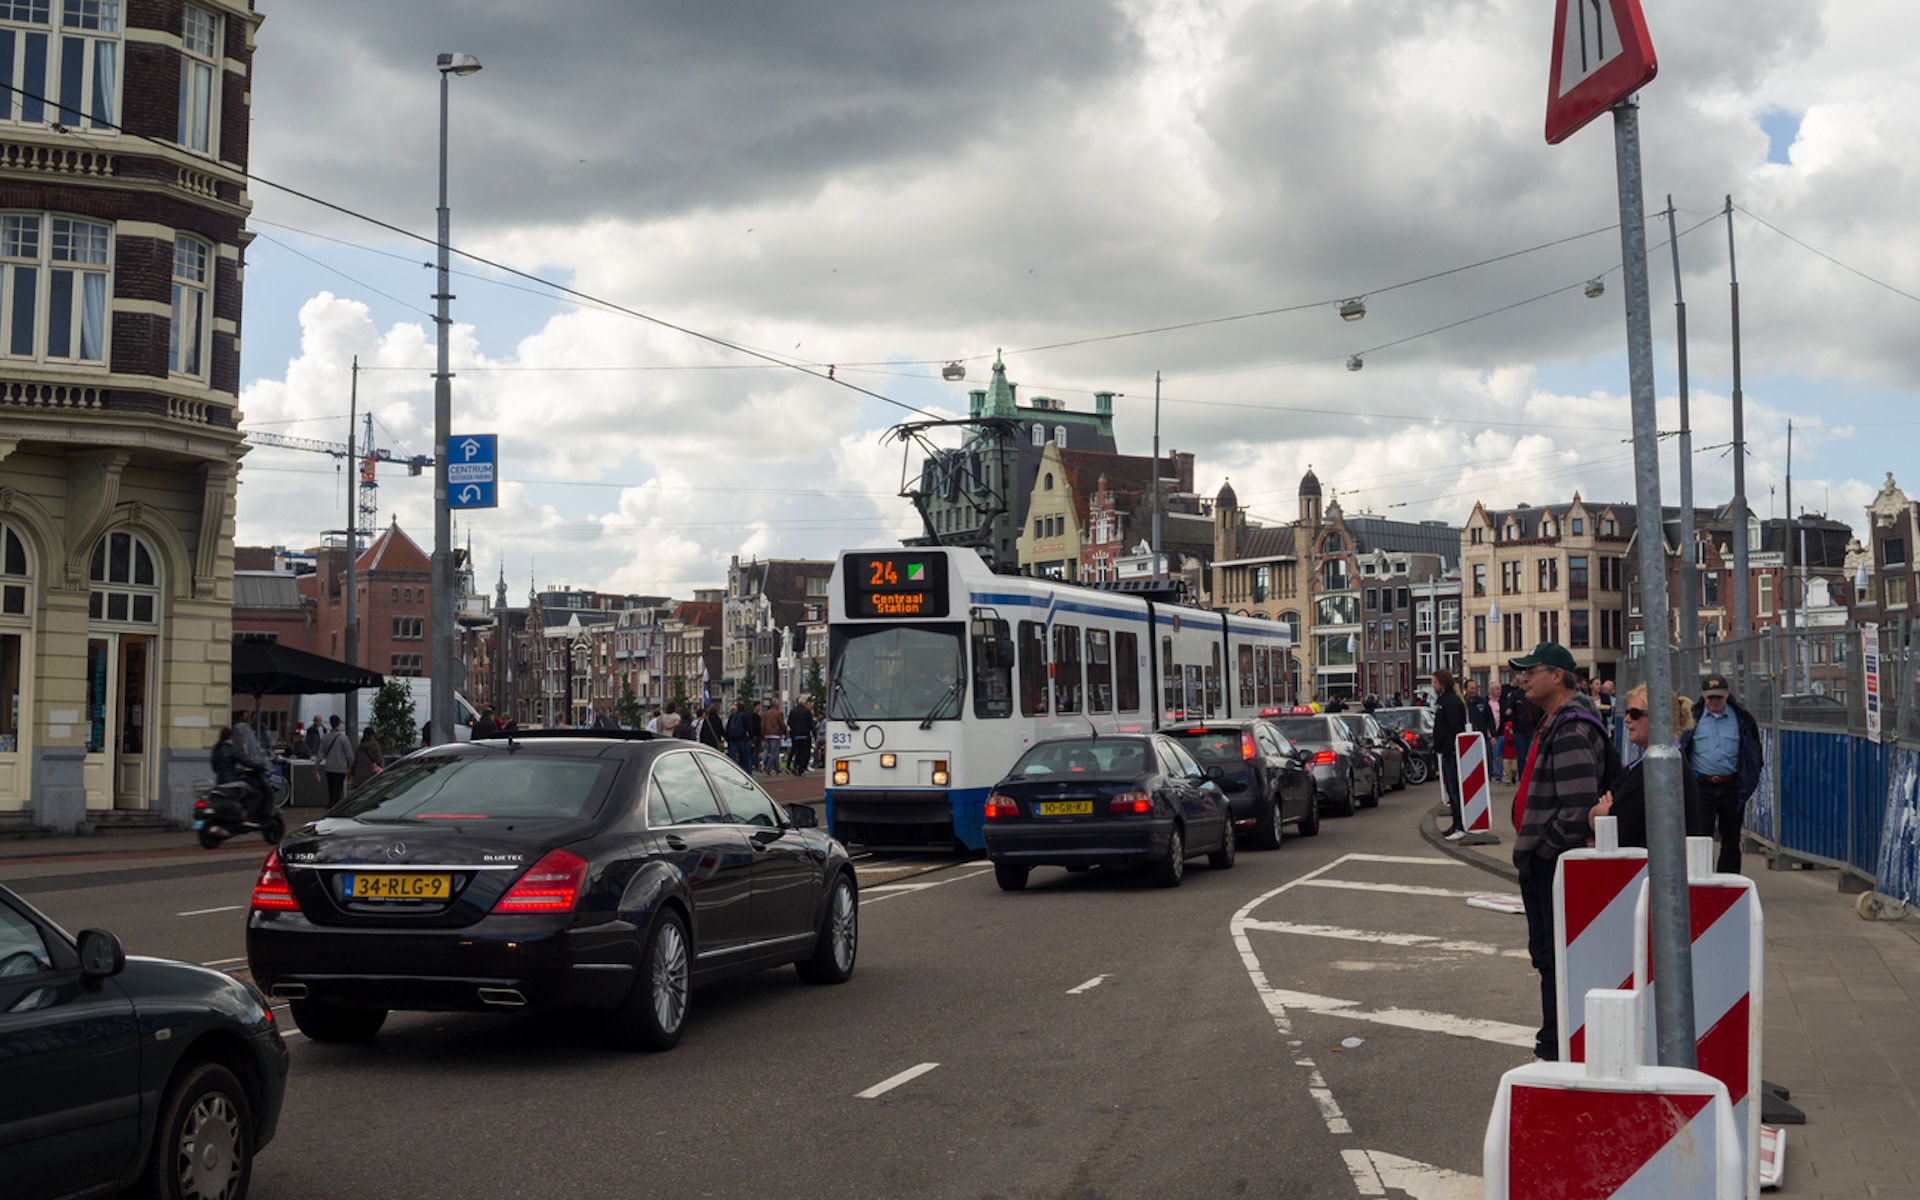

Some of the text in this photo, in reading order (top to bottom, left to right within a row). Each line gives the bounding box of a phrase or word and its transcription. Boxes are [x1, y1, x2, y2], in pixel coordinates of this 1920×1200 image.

[465, 445, 478, 462] P
[450, 465, 492, 474] CENTRUM
[869, 560, 898, 585] 24
[871, 593, 923, 604] Centraal
[877, 603, 920, 613] Station
[832, 733, 852, 743] 831
[1045, 802, 1089, 814] 10-GR-KJ
[358, 878, 443, 896] 34-RLG-9
